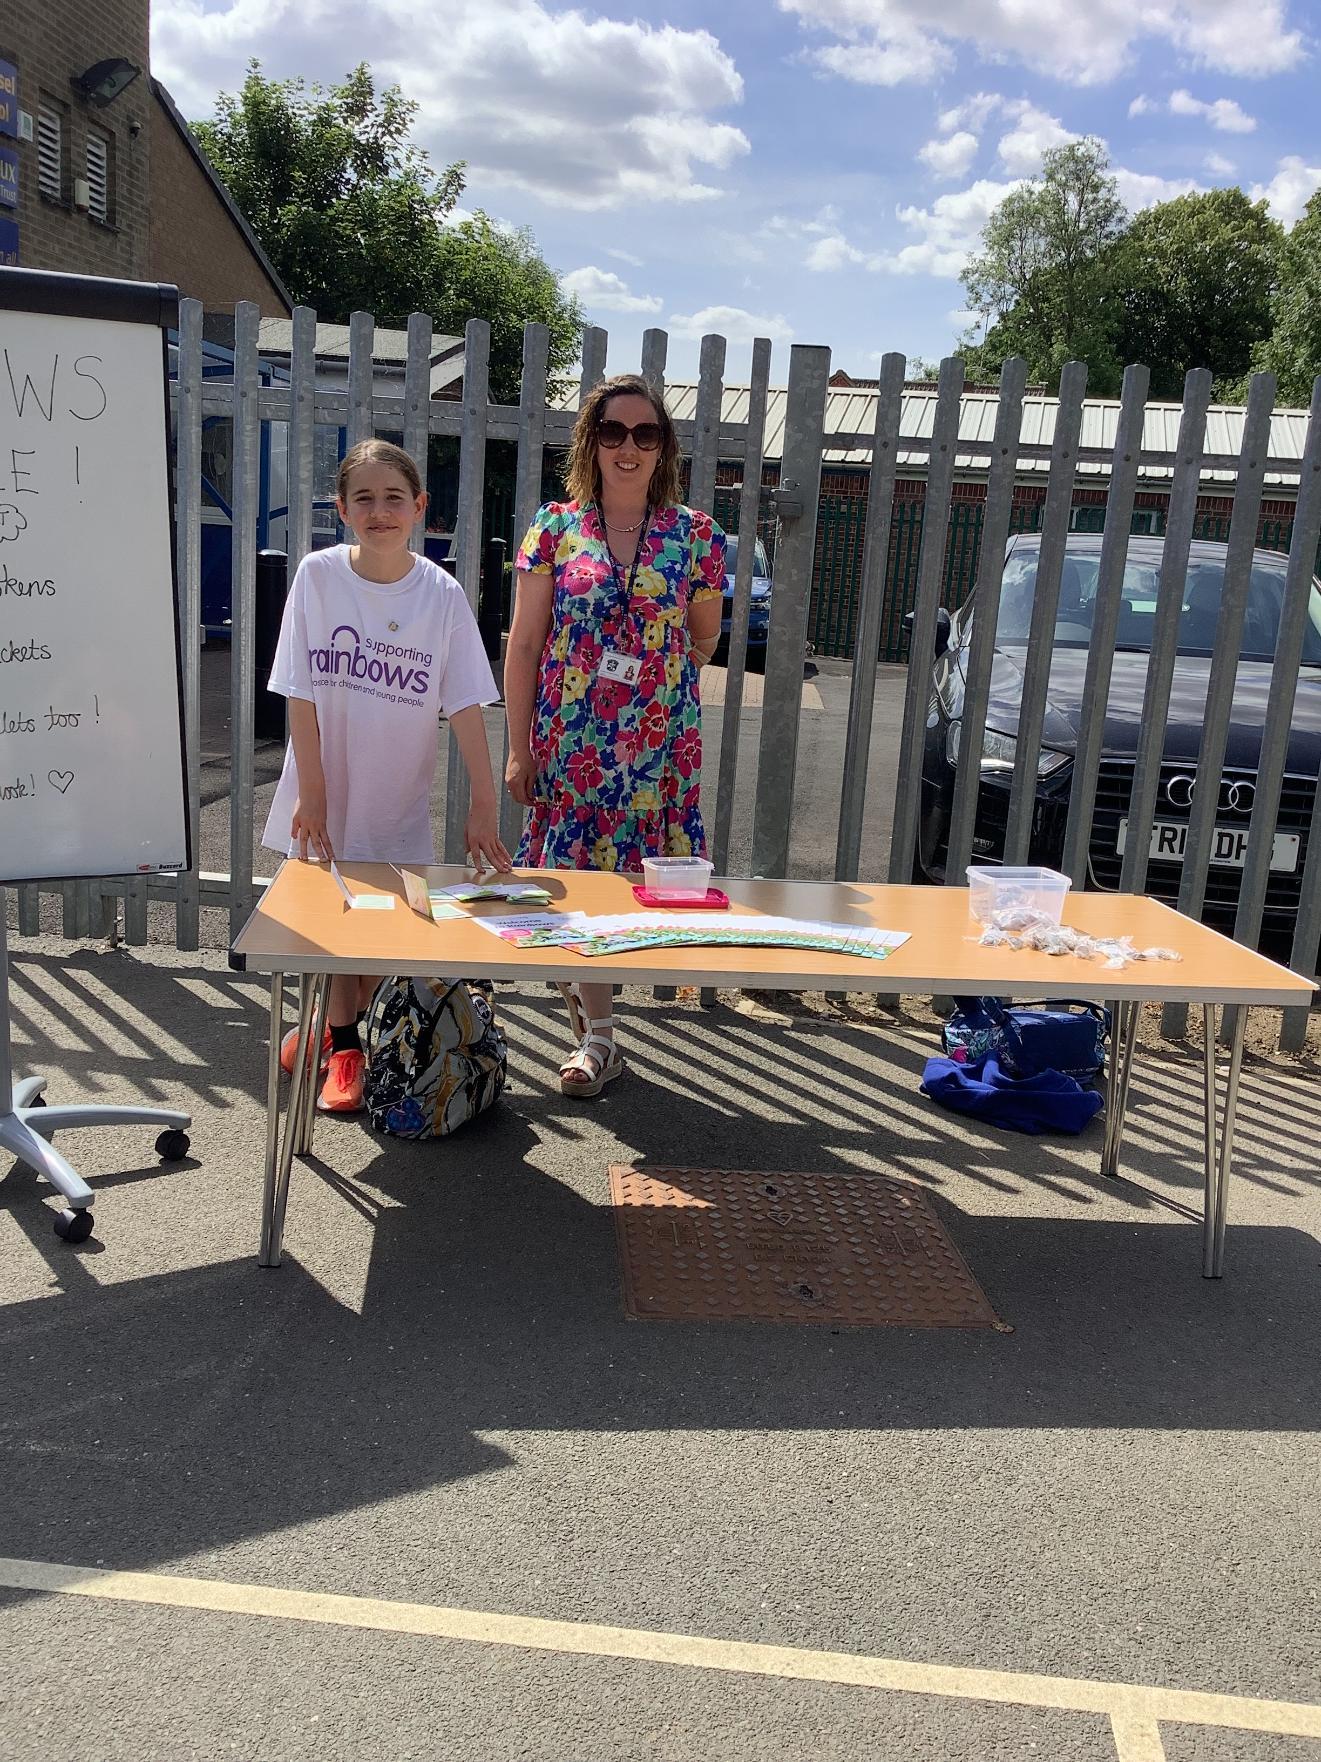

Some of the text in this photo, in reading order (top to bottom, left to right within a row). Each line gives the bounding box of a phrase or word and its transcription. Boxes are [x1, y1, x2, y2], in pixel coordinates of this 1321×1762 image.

[0, 563, 56, 598] kens
[0, 638, 52, 664] ckets
[308, 642, 430, 694] rainbows
[397, 696, 425, 709] people
